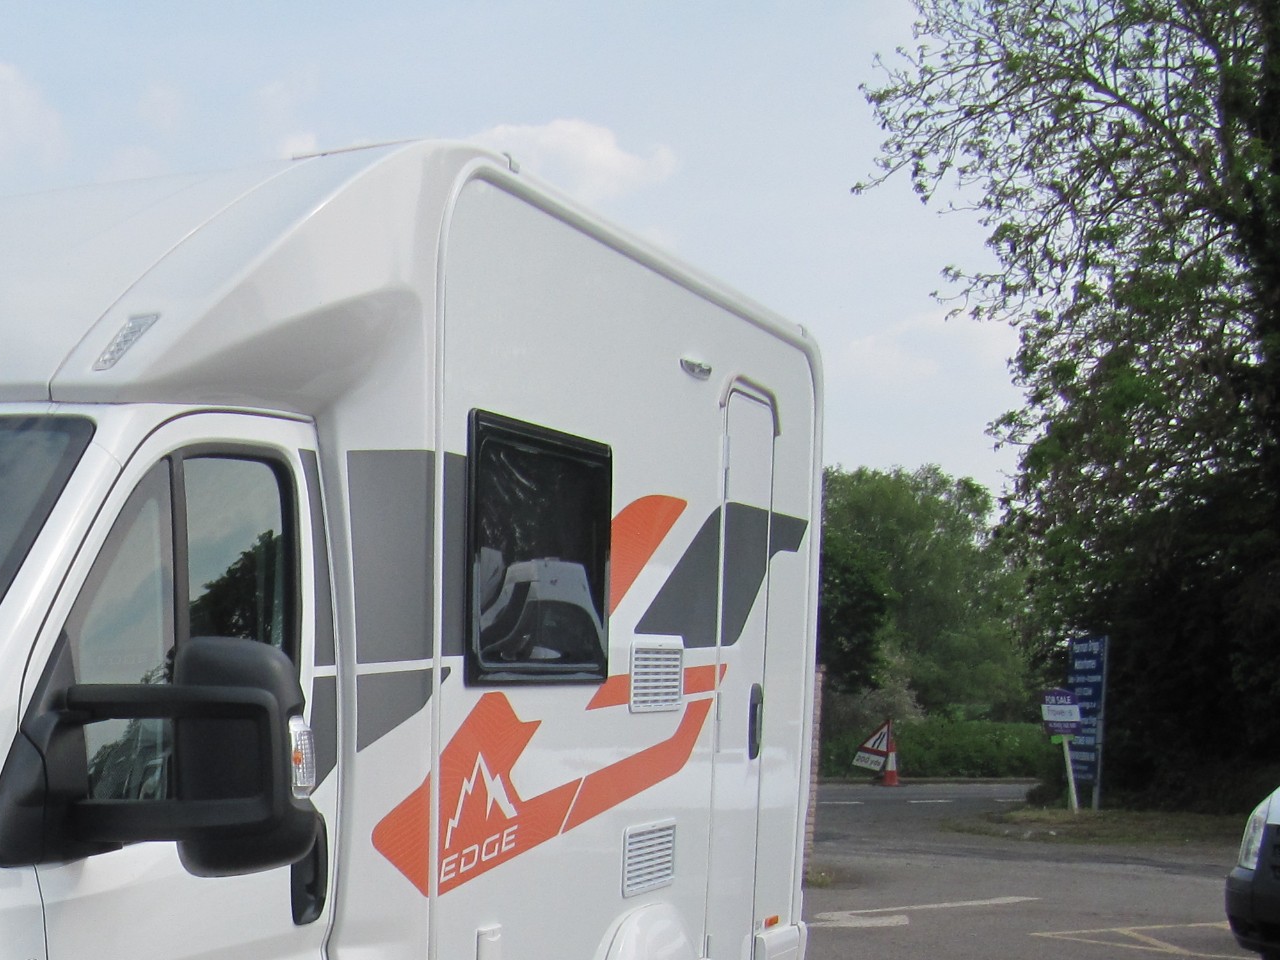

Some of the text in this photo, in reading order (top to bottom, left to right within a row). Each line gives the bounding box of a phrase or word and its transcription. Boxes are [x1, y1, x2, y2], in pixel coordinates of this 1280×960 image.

[1045, 695, 1072, 704] FOR SALE
[439, 823, 519, 884] EDGE
